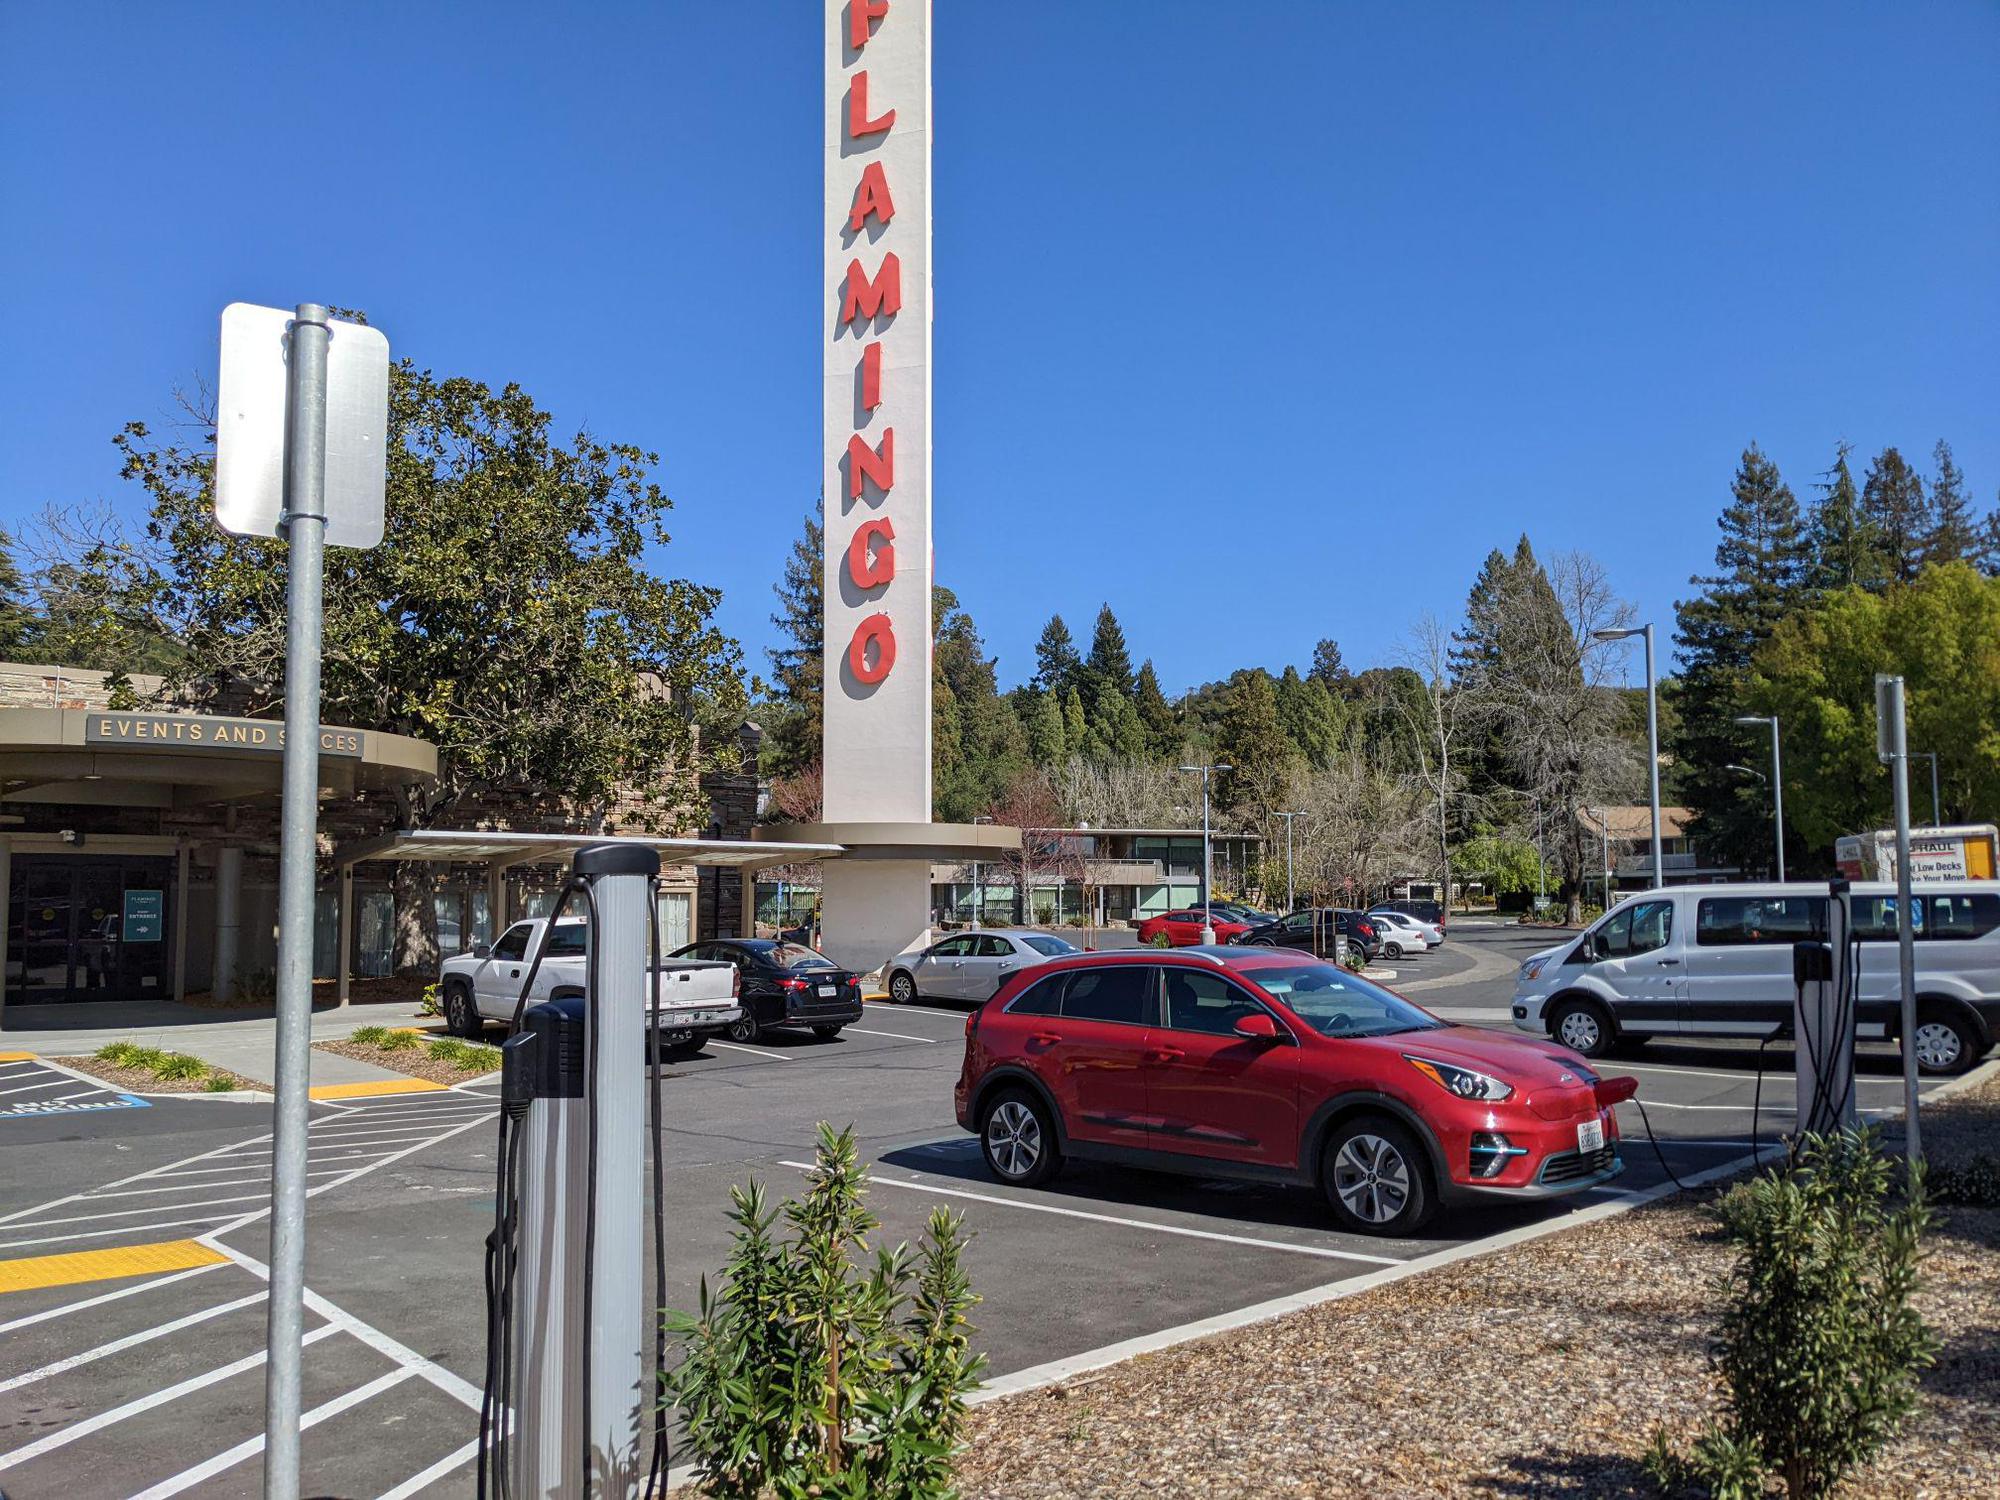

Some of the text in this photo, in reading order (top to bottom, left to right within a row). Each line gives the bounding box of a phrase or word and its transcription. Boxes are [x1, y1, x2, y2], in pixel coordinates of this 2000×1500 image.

[843, 0, 902, 684] FLAMINGO
[100, 719, 357, 751] EVENTS AND SCES
[1917, 863, 1934, 872] Low
[1936, 861, 1962, 871] Decks
[0, 1101, 133, 1115] ARKING
